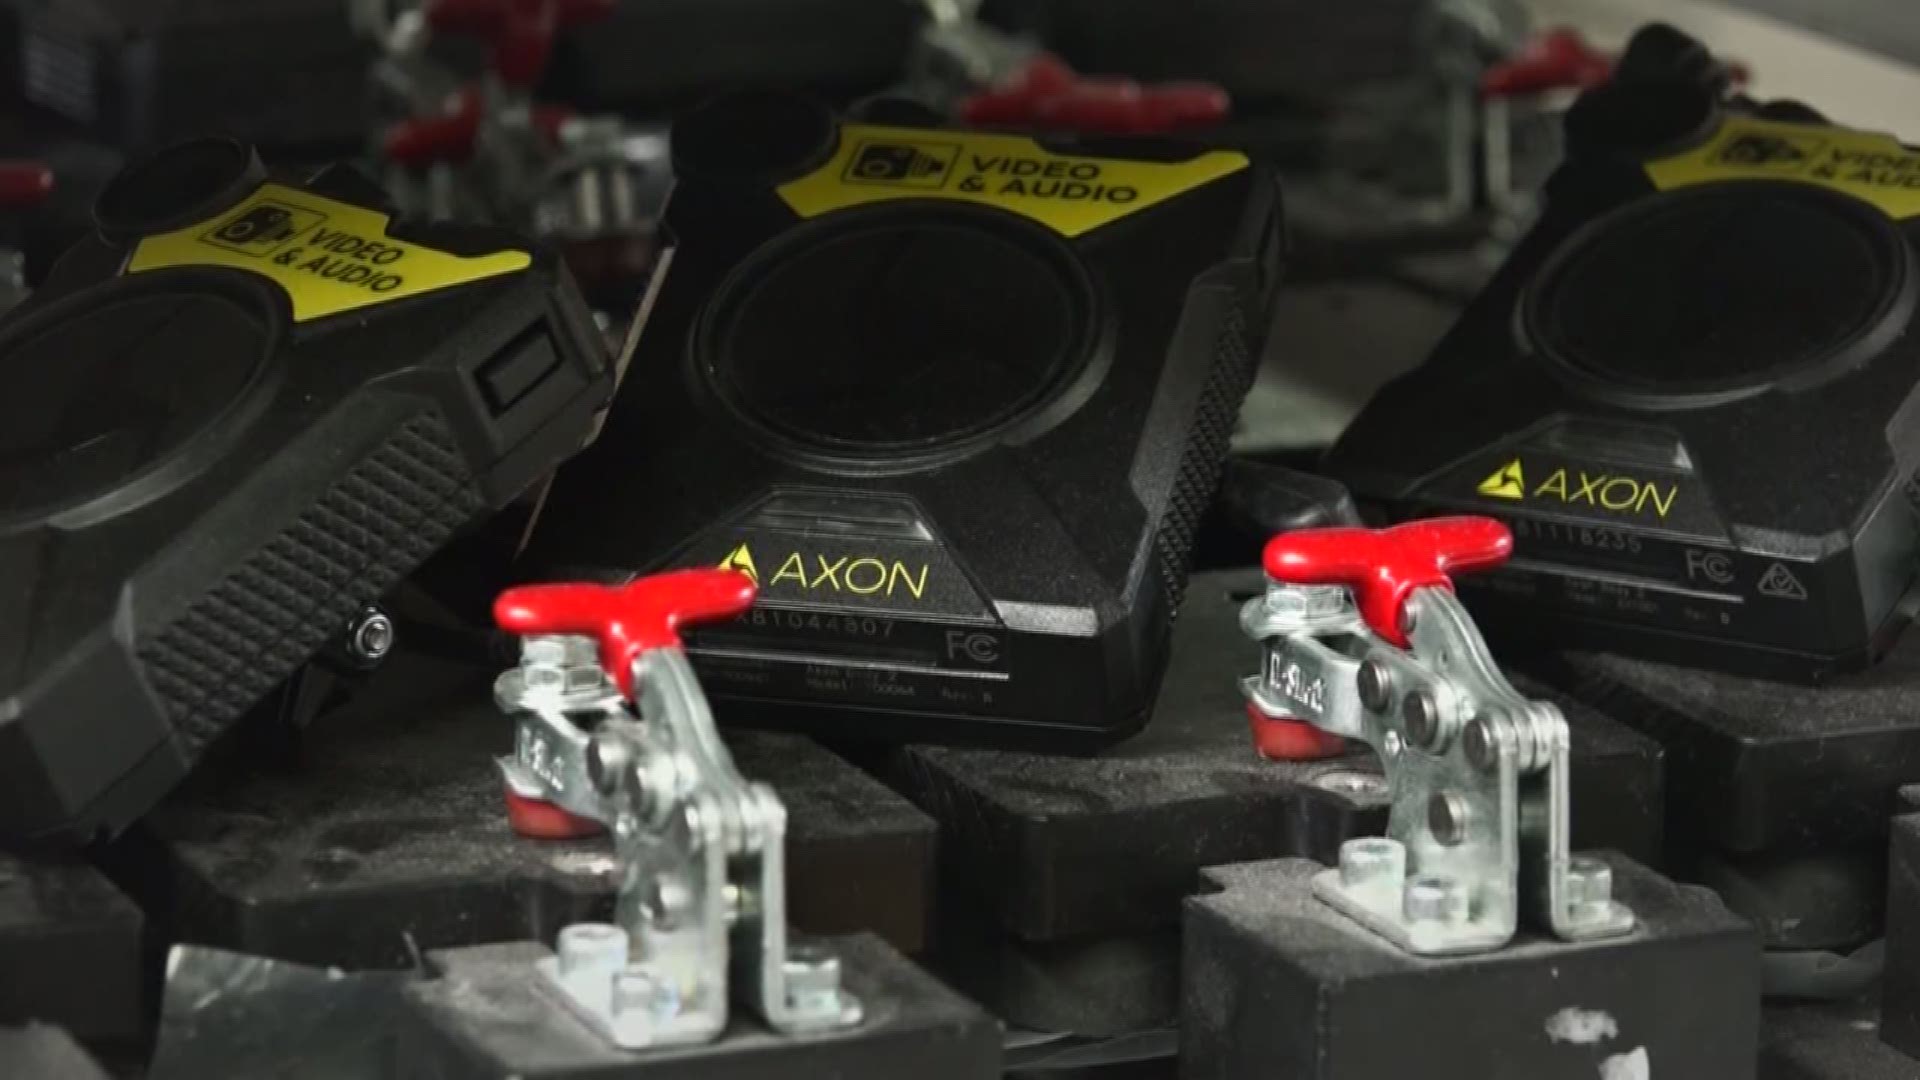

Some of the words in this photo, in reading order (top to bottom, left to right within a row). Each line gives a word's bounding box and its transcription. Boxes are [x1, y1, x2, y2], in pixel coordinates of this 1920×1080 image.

[973, 154, 1101, 180] VIDEO
[958, 175, 985, 193] &
[998, 178, 1139, 205] AUDIO
[308, 227, 404, 265] VIDEO
[273, 246, 305, 265] &
[296, 254, 403, 293] AUDIO
[1532, 467, 1678, 518] AXON
[770, 551, 929, 600] AXON
